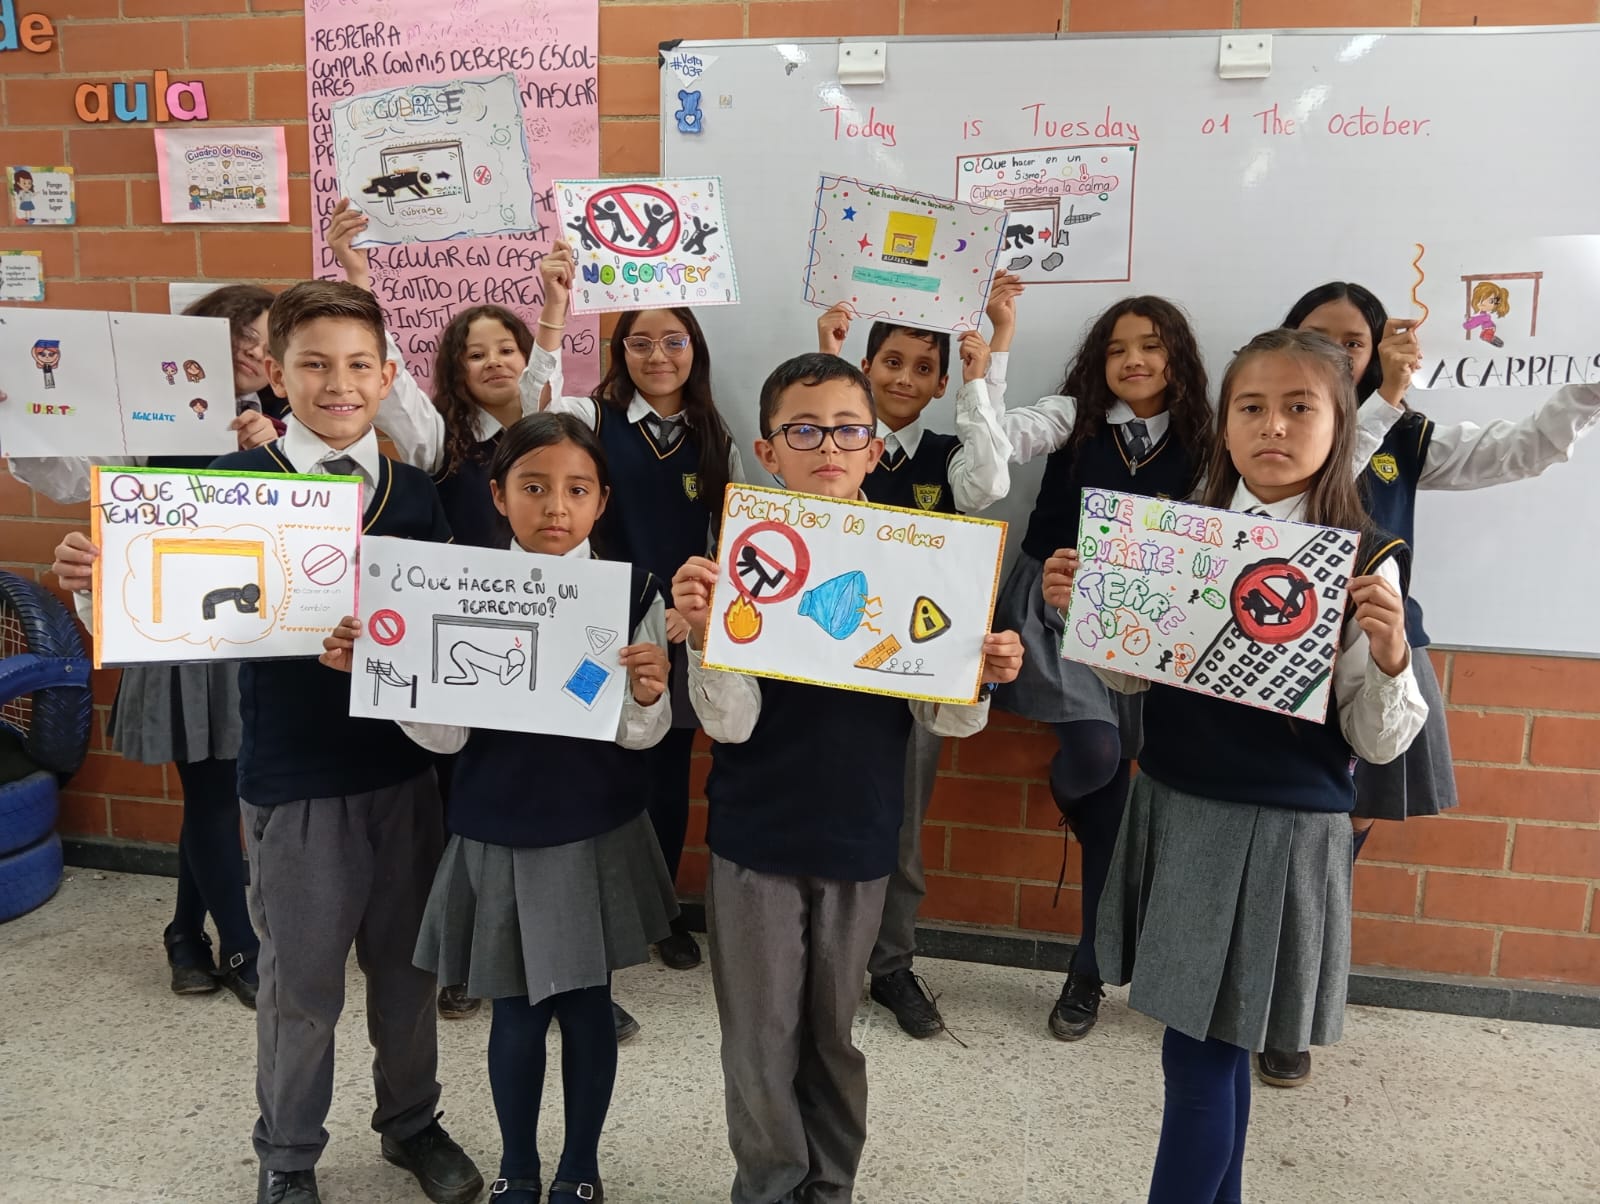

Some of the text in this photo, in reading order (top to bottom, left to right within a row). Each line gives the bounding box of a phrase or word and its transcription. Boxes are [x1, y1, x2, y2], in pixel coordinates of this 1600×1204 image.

[315, 21, 401, 52] RESPETAR A
[312, 43, 597, 79] CUMPLIR CON MIS DEBERES ESCOL-
[74, 69, 208, 122] aula
[520, 77, 597, 108] MASCAR
[820, 103, 1432, 147] Today is Tuesday 01 The October.
[187, 147, 261, 161] Cuadro de honor
[975, 154, 1082, 174] ¿Que hacer en un
[1009, 188, 1016, 200] y
[1063, 180, 1072, 193] la
[1078, 178, 1111, 192] calma
[388, 246, 465, 270] CELULAR
[466, 246, 490, 268] EN
[582, 261, 616, 285] NO
[381, 275, 453, 302] SENTIDO
[458, 278, 481, 303] DE
[132, 411, 176, 422] AGACHATE
[110, 474, 331, 508] QUE HACER EN UN
[91, 501, 199, 528] TEMBLOR
[1084, 491, 1224, 547] QUE HACER
[1081, 536, 1228, 581] DURATE UN
[458, 577, 516, 593] HACER
[523, 581, 546, 595] EN
[558, 584, 579, 600] UN
[458, 596, 558, 619] TERREMOTO?
